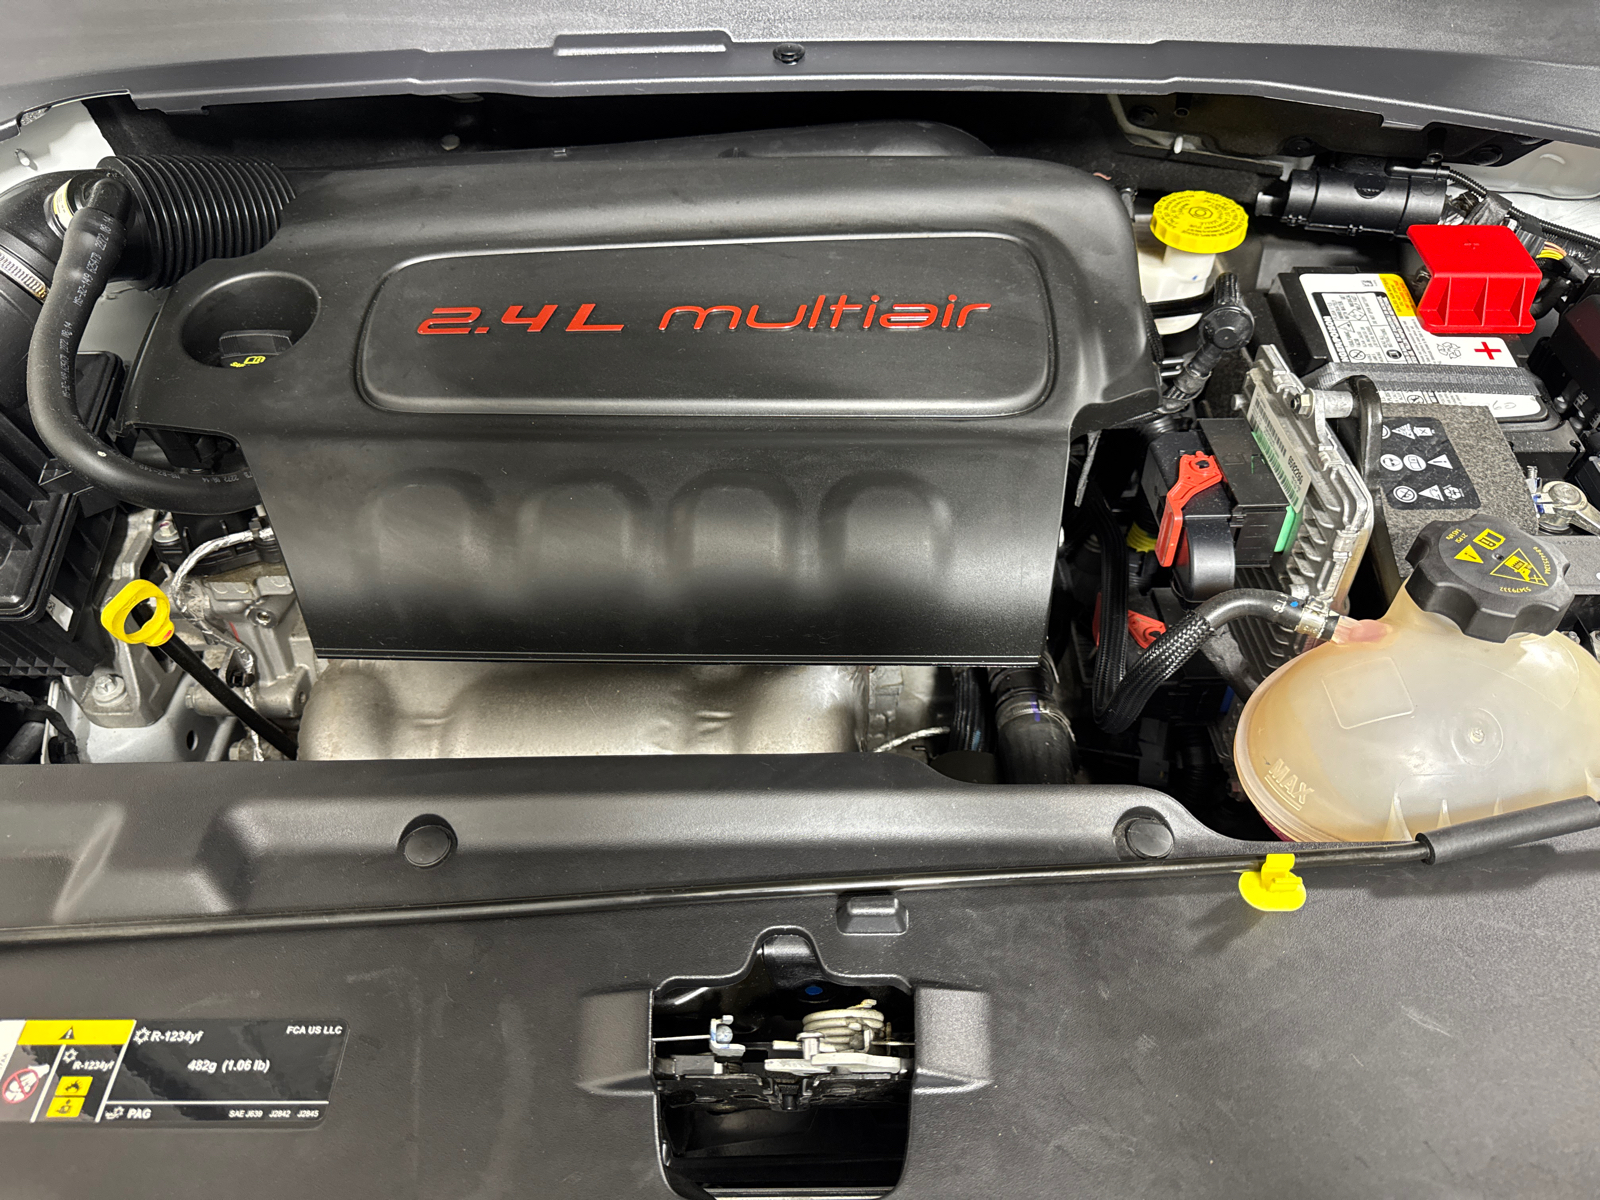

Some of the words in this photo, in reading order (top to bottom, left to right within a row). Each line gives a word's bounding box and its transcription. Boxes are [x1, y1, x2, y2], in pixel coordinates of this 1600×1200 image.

[658, 294, 993, 331] multiair
[1268, 758, 1315, 804] MAX
[286, 1025, 307, 1035] FCA
[308, 1026, 322, 1035] US
[322, 1026, 343, 1035] LLC
[150, 1030, 204, 1046] R-1234yf
[72, 1060, 114, 1072] R-1234yf
[187, 1060, 217, 1074] 482g
[222, 1059, 252, 1074] (1.06
[254, 1059, 270, 1073] lb)
[126, 1108, 152, 1120] PAG
[228, 1109, 244, 1118] SAE
[245, 1109, 264, 1118] J639
